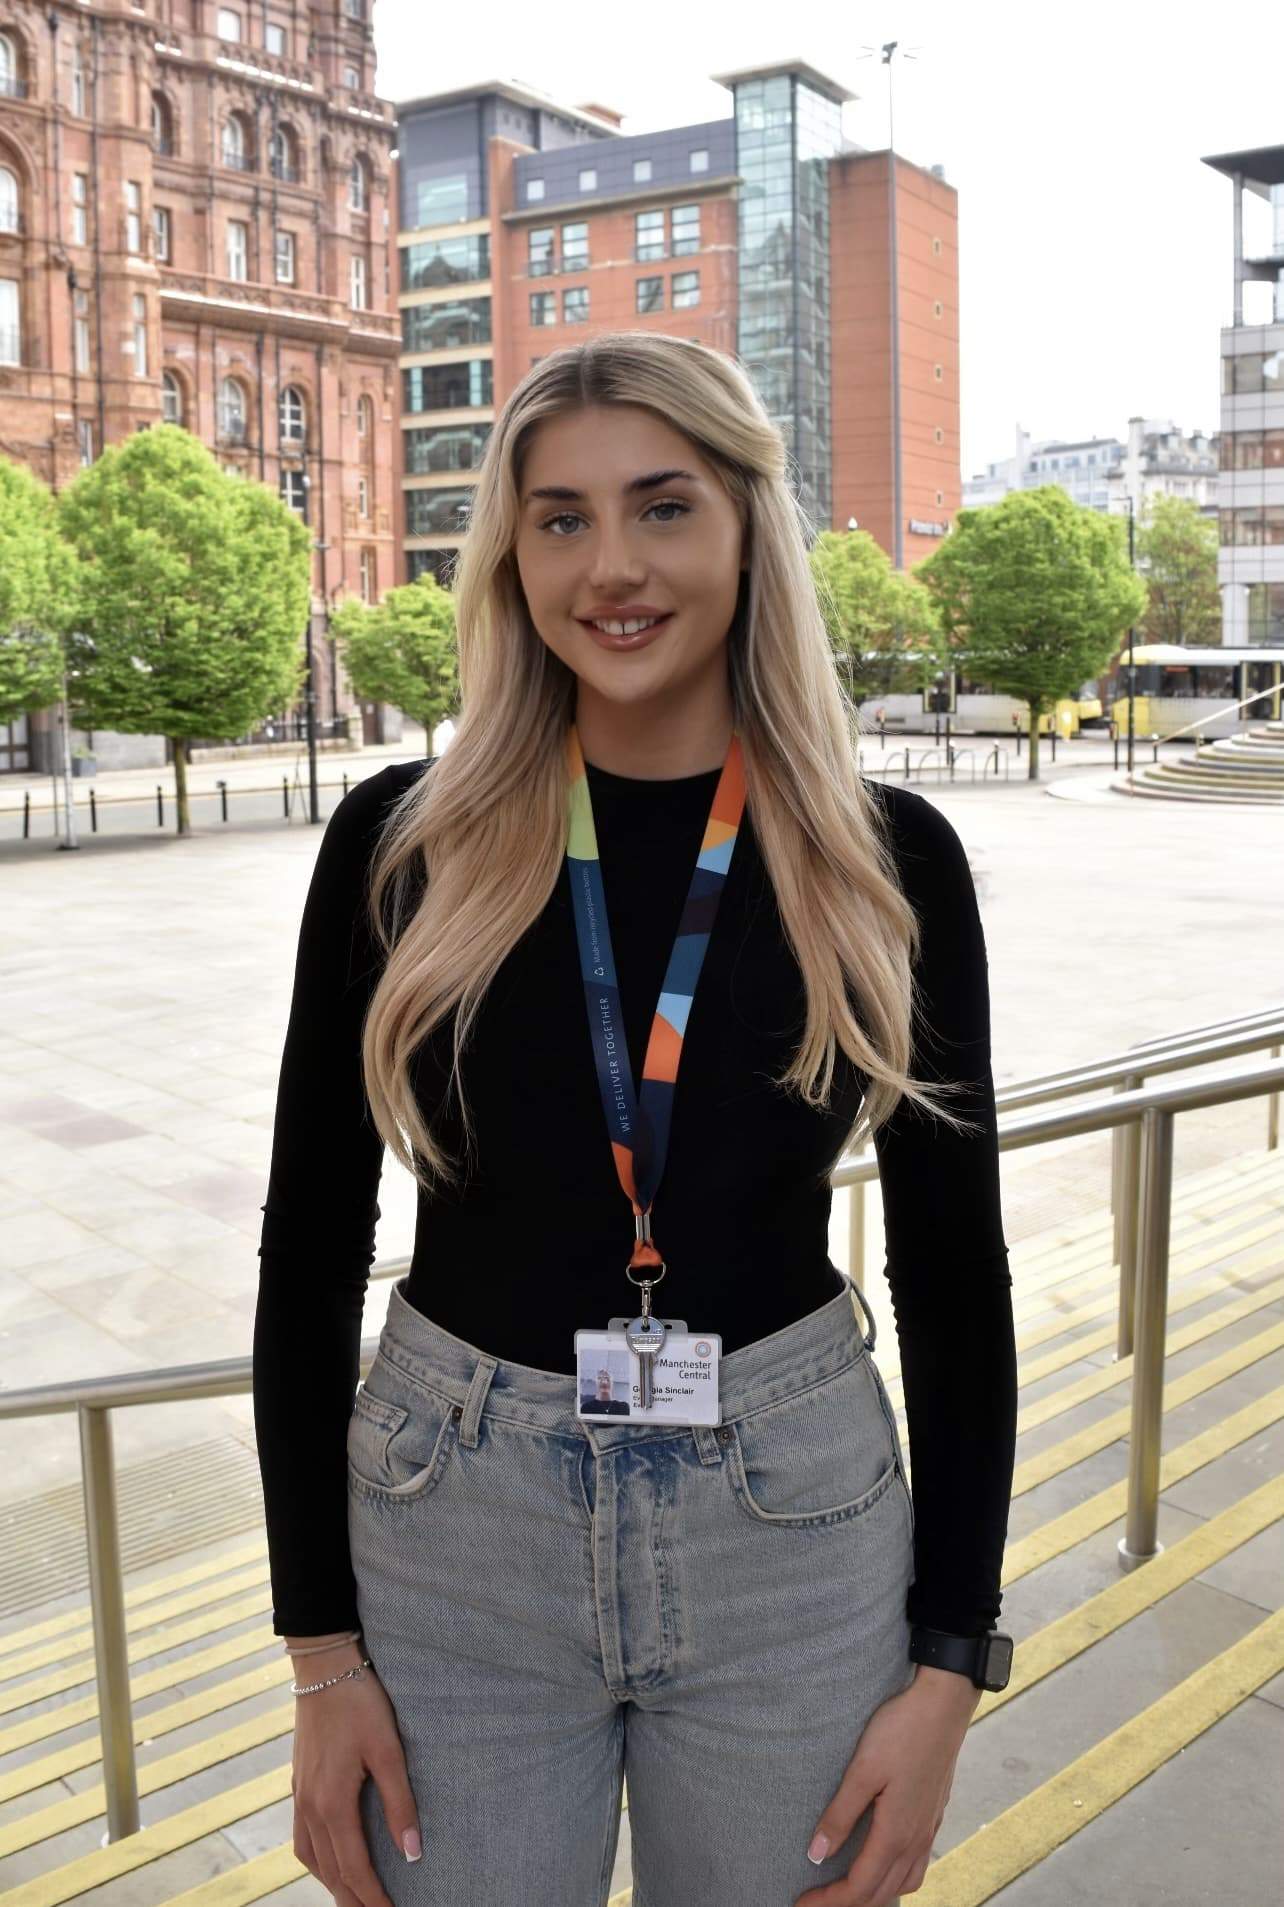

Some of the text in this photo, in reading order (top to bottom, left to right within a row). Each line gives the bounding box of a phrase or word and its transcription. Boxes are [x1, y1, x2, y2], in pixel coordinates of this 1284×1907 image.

[592, 945, 601, 963] Made
[599, 997, 632, 1133] WE DELIVER TOGETHER
[659, 1359, 711, 1370] Manchester
[678, 1370, 711, 1380] Central
[665, 1386, 695, 1395] Sinclair
